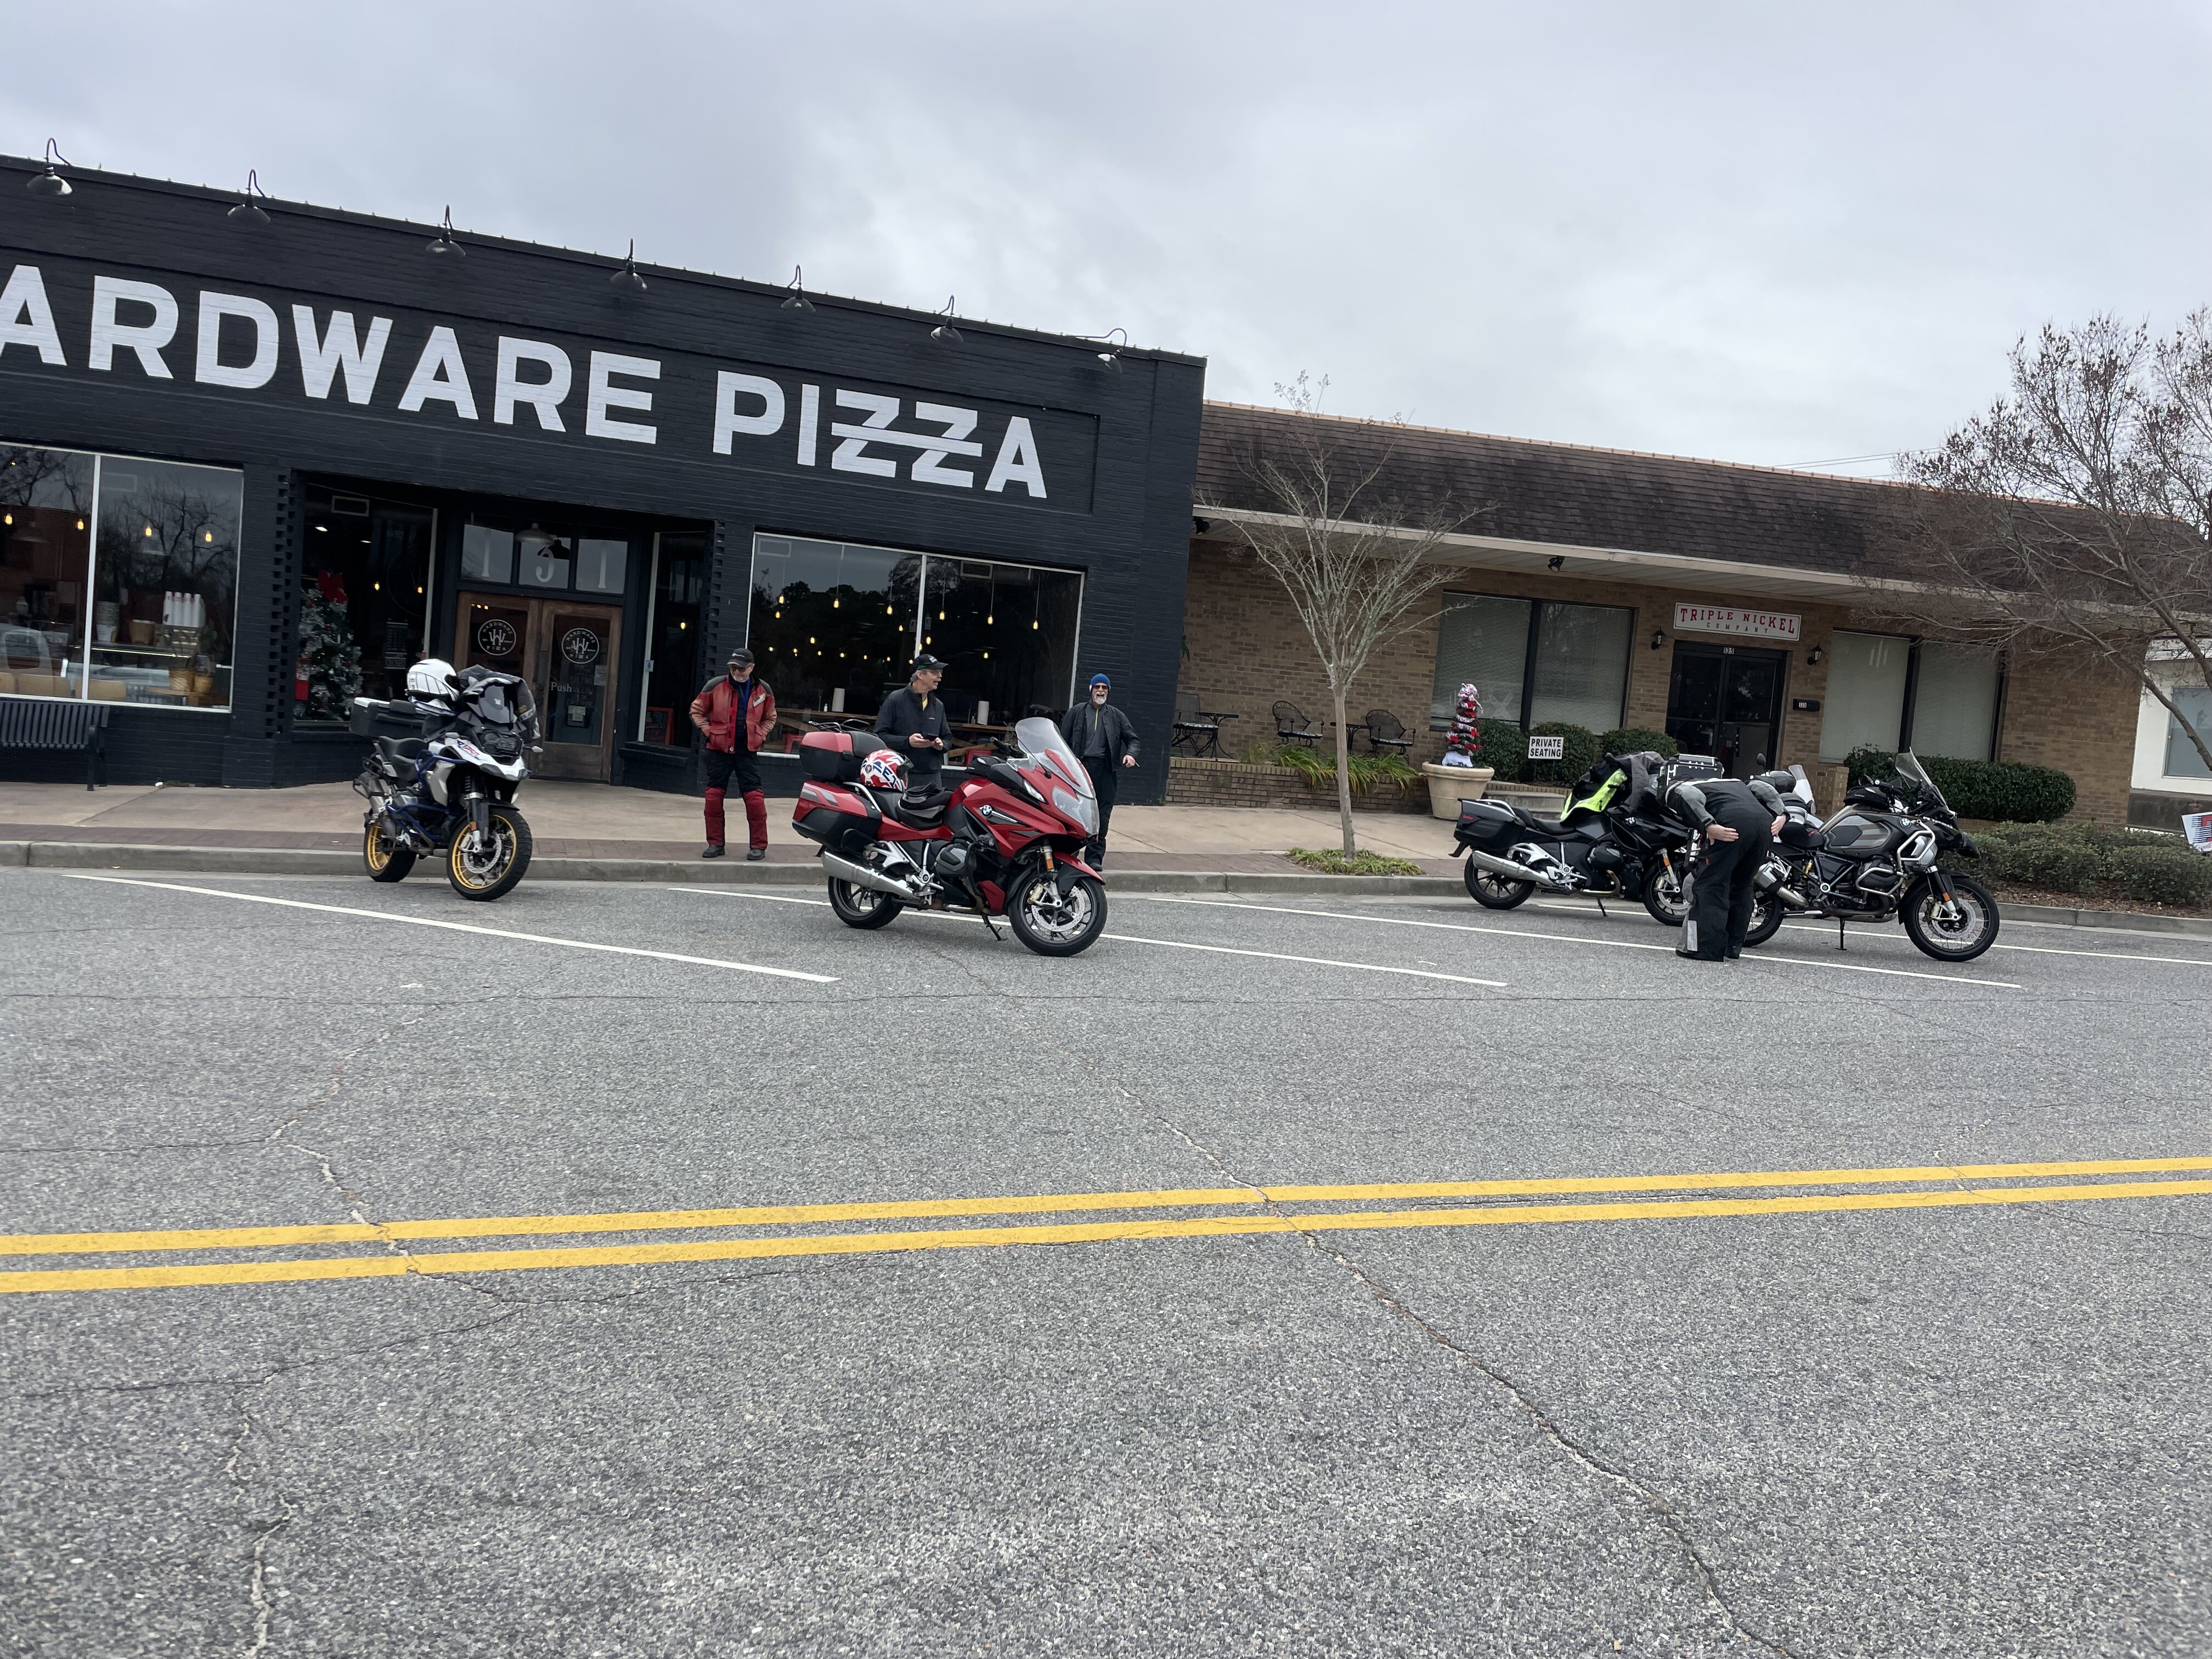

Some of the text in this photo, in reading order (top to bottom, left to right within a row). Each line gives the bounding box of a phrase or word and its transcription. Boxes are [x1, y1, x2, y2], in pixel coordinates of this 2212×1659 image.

[0, 264, 1047, 499] ARDWARE PIZZA
[1680, 608, 1795, 634] TRIPLE NICKEL
[1707, 622, 1768, 634] COMPANY
[551, 681, 572, 693] Push
[1531, 738, 1561, 747] PRIVATE
[1530, 748, 1561, 757] SEATING
